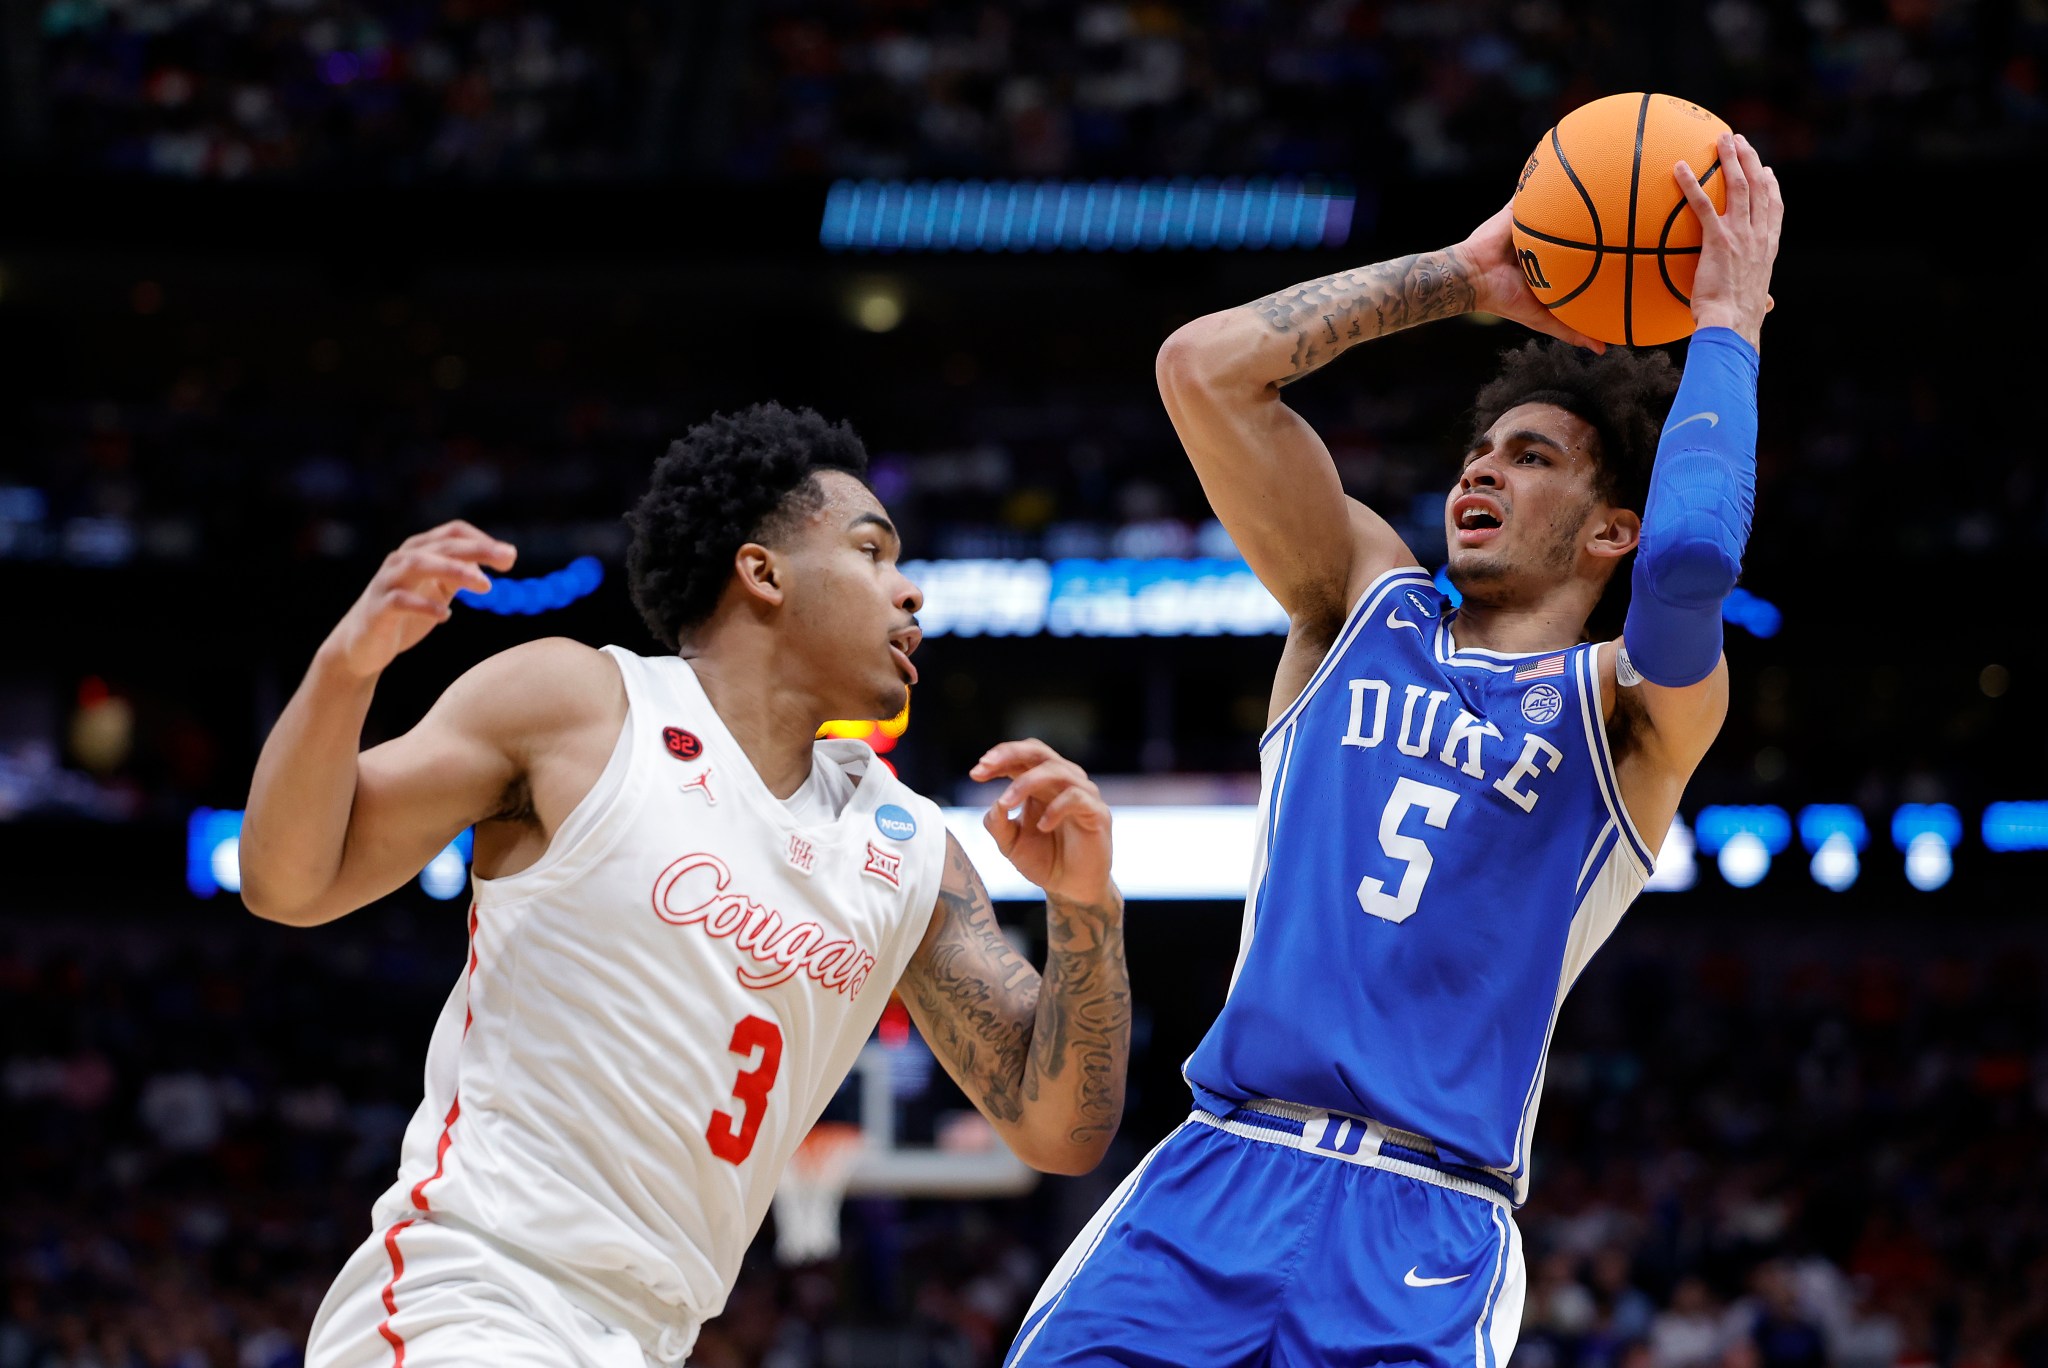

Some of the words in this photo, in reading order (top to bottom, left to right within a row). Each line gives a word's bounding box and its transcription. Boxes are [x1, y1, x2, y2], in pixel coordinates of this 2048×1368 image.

[1341, 679, 1563, 813] DUKE
[1528, 697, 1558, 708] ACC
[881, 818, 915, 833] NCAA
[1357, 777, 1461, 924] 5
[706, 1014, 783, 1166] 3
